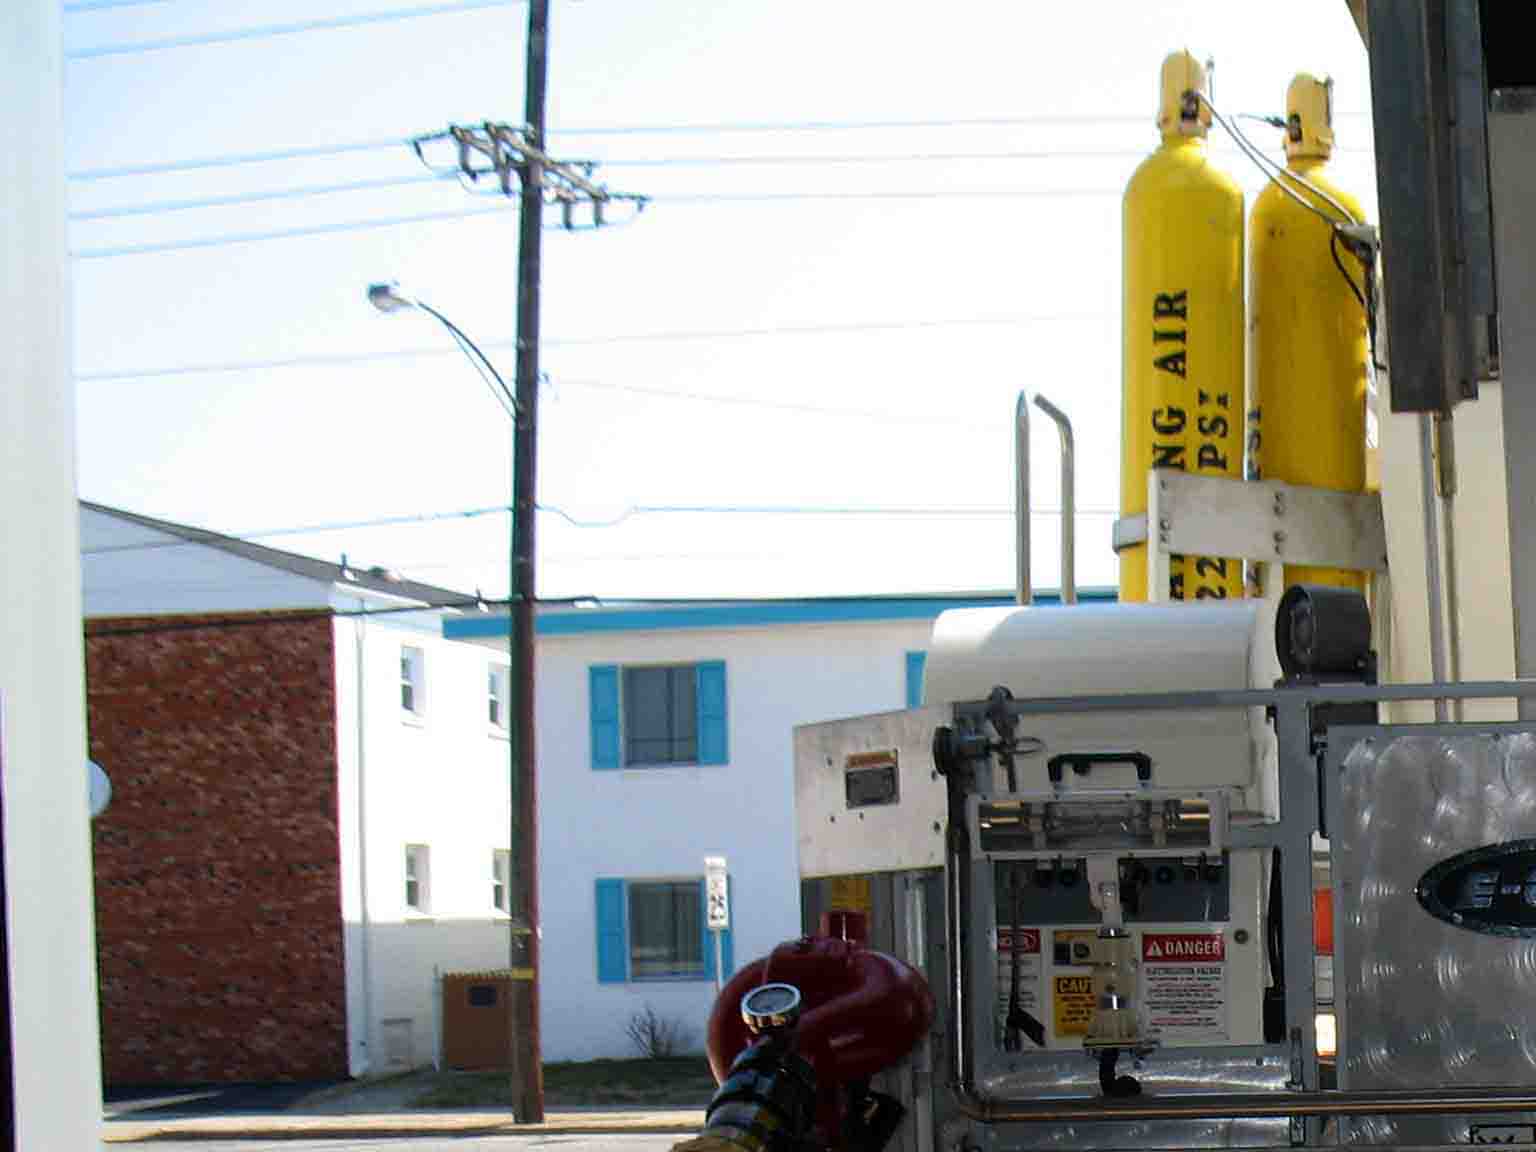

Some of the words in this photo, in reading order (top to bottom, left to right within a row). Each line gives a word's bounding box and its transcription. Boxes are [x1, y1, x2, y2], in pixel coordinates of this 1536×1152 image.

[1153, 289, 1187, 378] AIR
[1198, 387, 1229, 470] PSI
[1166, 941, 1221, 955] DANGER
